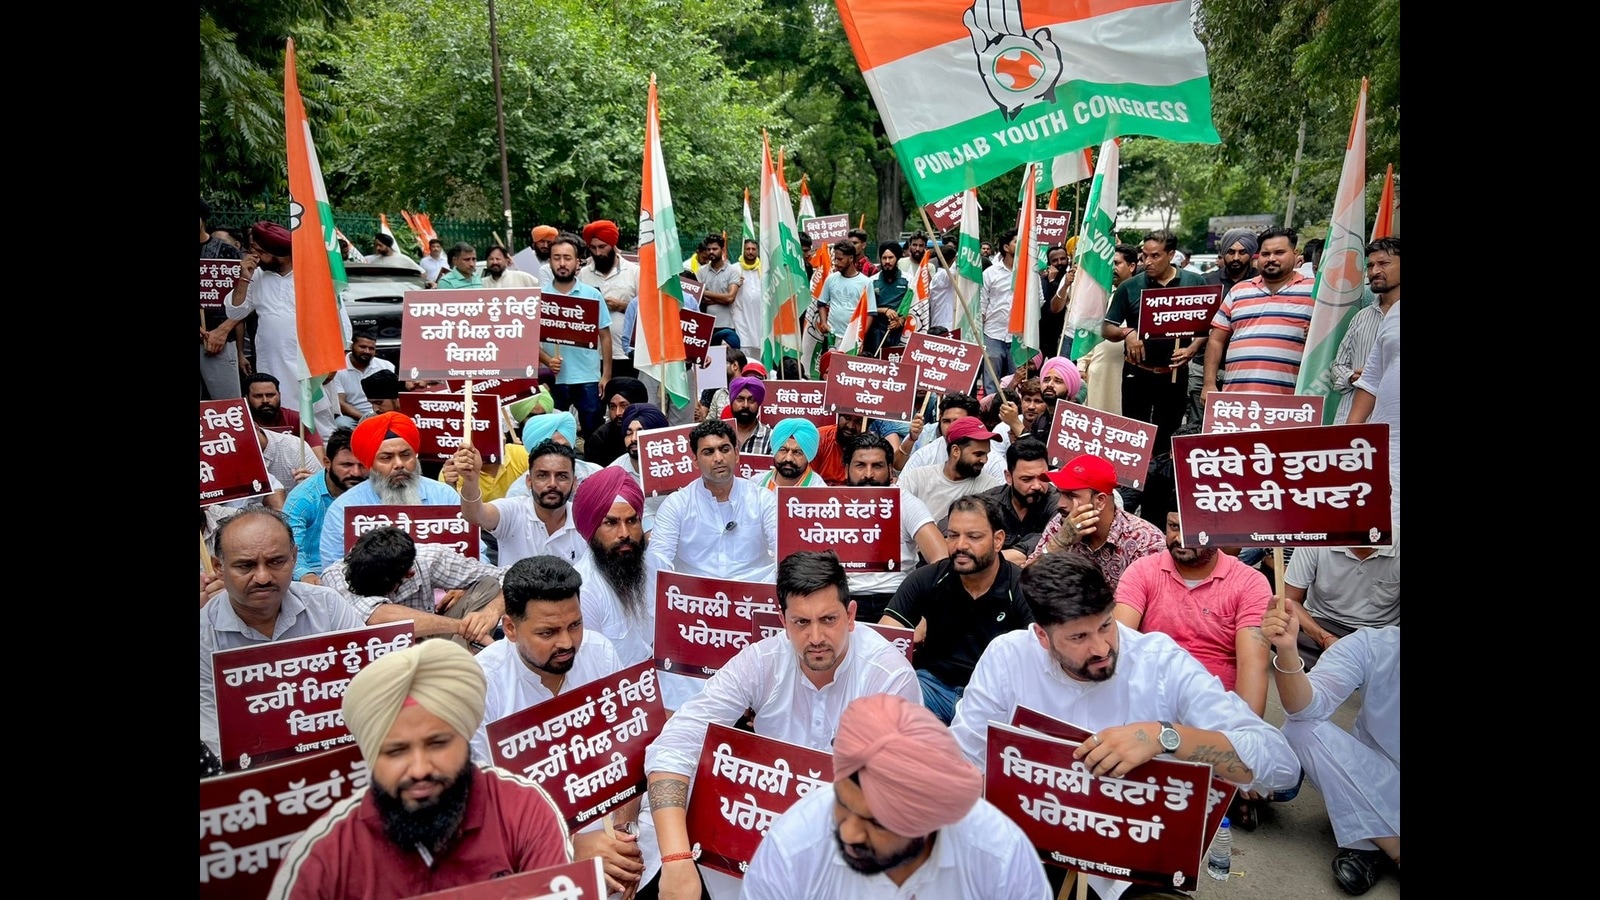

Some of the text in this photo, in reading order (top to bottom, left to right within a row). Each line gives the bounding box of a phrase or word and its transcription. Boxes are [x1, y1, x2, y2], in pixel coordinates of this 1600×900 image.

[914, 137, 992, 179] PUNJAB
[992, 110, 1069, 147] YOUTH
[1074, 94, 1190, 125] CONGRESS
[215, 277, 234, 288] ਰਹੀ
[409, 295, 540, 322] ਹਸਪਤਾਲਾਂ ਨੂੰ ਕਿਉਂ
[1146, 293, 1217, 307] ਆਪ ਸਰਕਾਰ
[561, 305, 585, 320] ਗਏ
[1152, 309, 1208, 325] ਮੁਰਦਾਬਾਦ
[421, 318, 525, 340] ਨਹੀਂ ਮਿਲ ਰਹੀ
[567, 321, 596, 333] ਪਲਾਂਟ?
[445, 341, 500, 363] ਬਿਜਲੀ
[923, 339, 967, 358] ਬਦਲਾਅ ਨੇ
[847, 360, 899, 377] ਬਦਲਾਅ ਨੇ
[910, 351, 935, 366] ਪੰਜਾਬ
[949, 358, 971, 372] ਕੀਤਾ
[835, 374, 865, 388] ਪੰਜਾਬ
[881, 379, 907, 392] ਕੀਤਾ
[923, 368, 947, 381] ਹਨੇਰਾ
[776, 388, 823, 404] ਕਿੱਥੇ ਗਏ
[856, 391, 884, 404] ਹਨੇਰਾ
[203, 406, 245, 431] ਕਿਉਂ
[778, 406, 805, 416] ਥਰਮਲ
[1212, 400, 1315, 425] ਕਿੱਥੇ ਹੈ ਤੁਹਾਡੀ
[1060, 409, 1149, 449] ਕਿੱਥੇ ਹੈ ਤੁਹਾਡੀ
[202, 432, 236, 456] ਰਹੀ
[645, 435, 688, 459] ਕਿੱਥੇ ਹੈ
[1057, 429, 1142, 467] ਕੋਲੇ ਦੀ ਖਾਣ?
[649, 455, 693, 478] ਕੋਲੇ ਦੀ
[1186, 437, 1377, 480] ਕਿੱਥੇ ਹੈ ਤੁਹਾਡੀ
[786, 497, 894, 519] ਬਿਜਲੀ ਕੱਟਾਂ ਤੋਂ
[1192, 480, 1372, 513] ਕੋਲੇ ਦੀ ਖਾਣ?
[798, 522, 881, 545] ਪਰੇਸ਼ਾਨ ਹਾਂ
[1250, 531, 1328, 543] ਪੰਜਾਬ ਯੂਥ ਕਾਂਗਰਸ
[665, 585, 732, 618] ਬਿਜਲੀ
[678, 619, 752, 649] ਪਰੇਸ਼ਾਨ
[223, 647, 338, 687] ਹਸਪਤਾਲਾਂ
[340, 641, 363, 673] ਨੂੰ
[245, 682, 297, 714] ਨਹੀਂ
[498, 668, 657, 760] ਹਸਪਤਾਲਾਂ ਨੂੰ ਕਿਉਂ
[295, 742, 319, 753] ਪੰਜਾਬ
[320, 740, 337, 750] ਯੂਥ
[523, 707, 649, 784] ਨਹੀਂ ਮਿਲ ਰਹੀ
[563, 751, 628, 804] ਬਿਜਲੀ
[712, 742, 793, 797] ਬਿਜਲੀ
[1000, 746, 1094, 796] ਬਿਜਲੀ
[1099, 774, 1160, 805] ਕਟਾਂ
[1163, 776, 1194, 811] ਤੋਂ
[200, 788, 271, 837] ਜਲੀ
[274, 770, 345, 816] ਕੱਟਾਂ
[576, 785, 637, 823] ਪੰਜਾਬ ਯੂਥ ਕਾਂਗਰਸ
[1018, 793, 1166, 844] ਪਰੇਸ਼ਾਨ ਹਾਂ
[1051, 851, 1132, 876] ਪੰਜਾਬ ਯੂਥ ਕਾਂਗਰਸ
